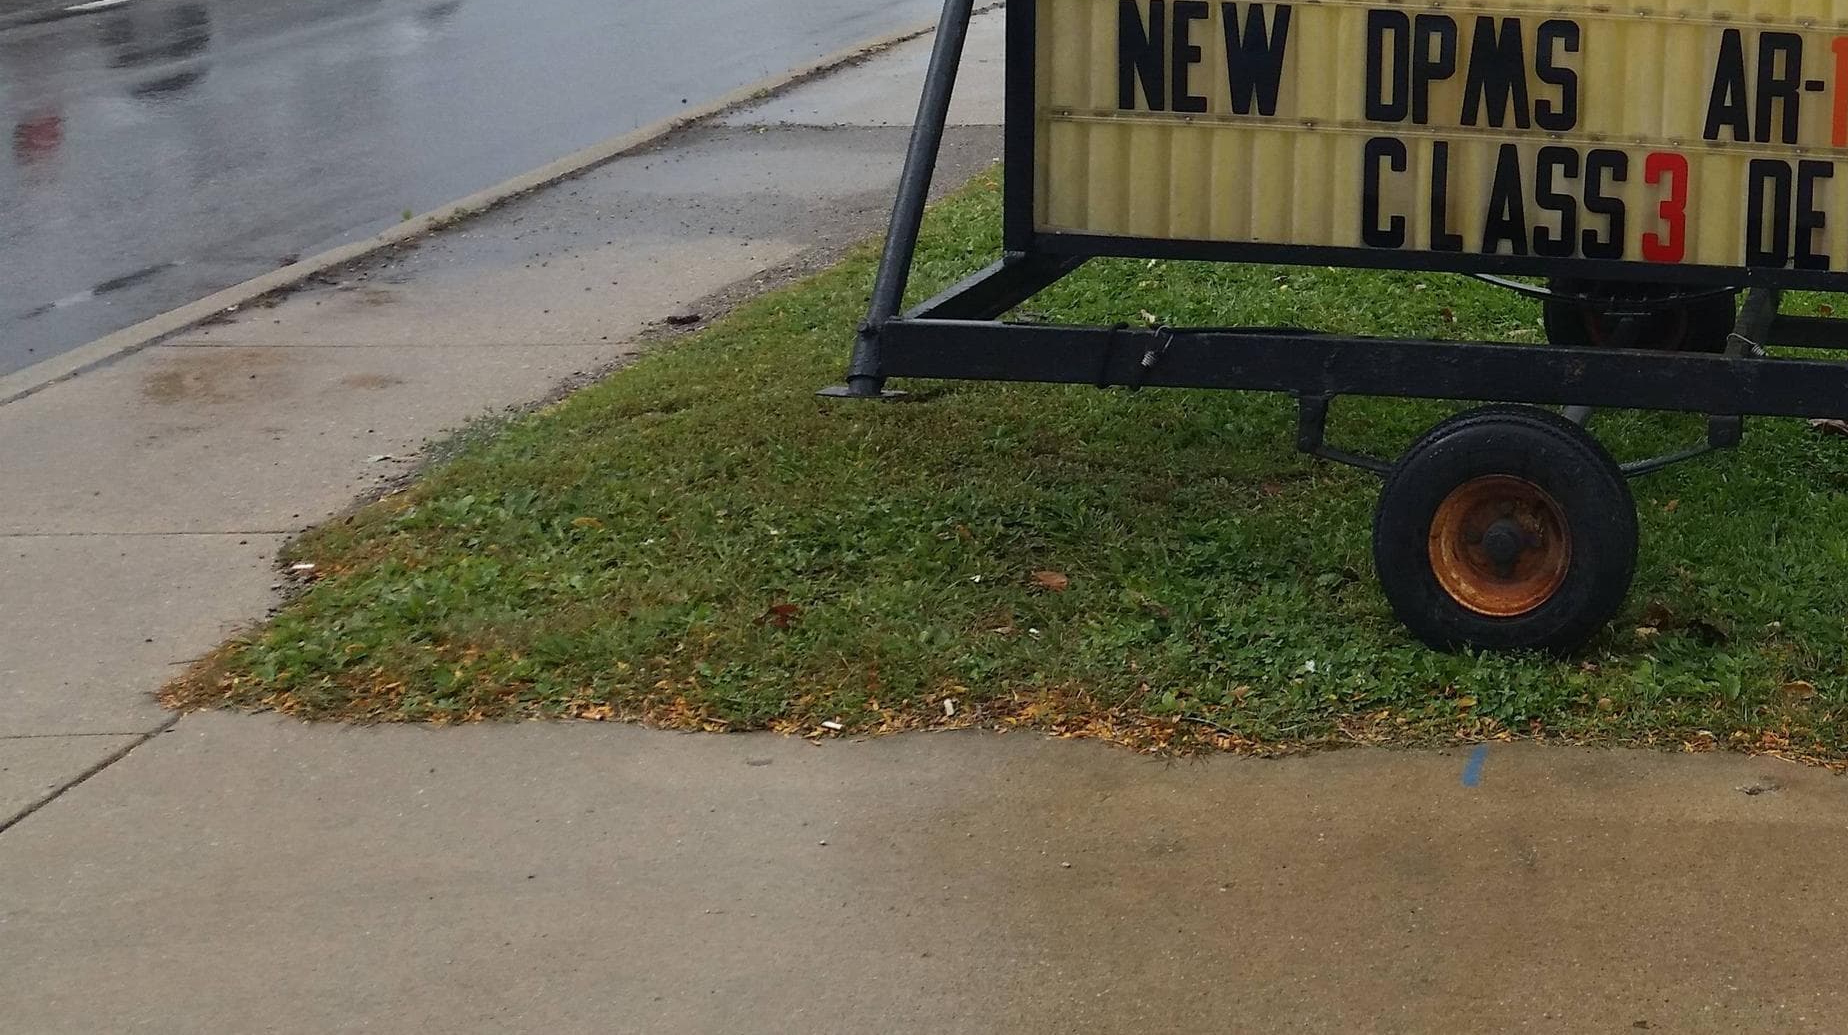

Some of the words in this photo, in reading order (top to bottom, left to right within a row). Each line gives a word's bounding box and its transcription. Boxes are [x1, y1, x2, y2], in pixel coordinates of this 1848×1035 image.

[1365, 9, 1580, 132] DPMS
[1361, 136, 1628, 260] CLASS
[1642, 152, 1689, 263] 3
